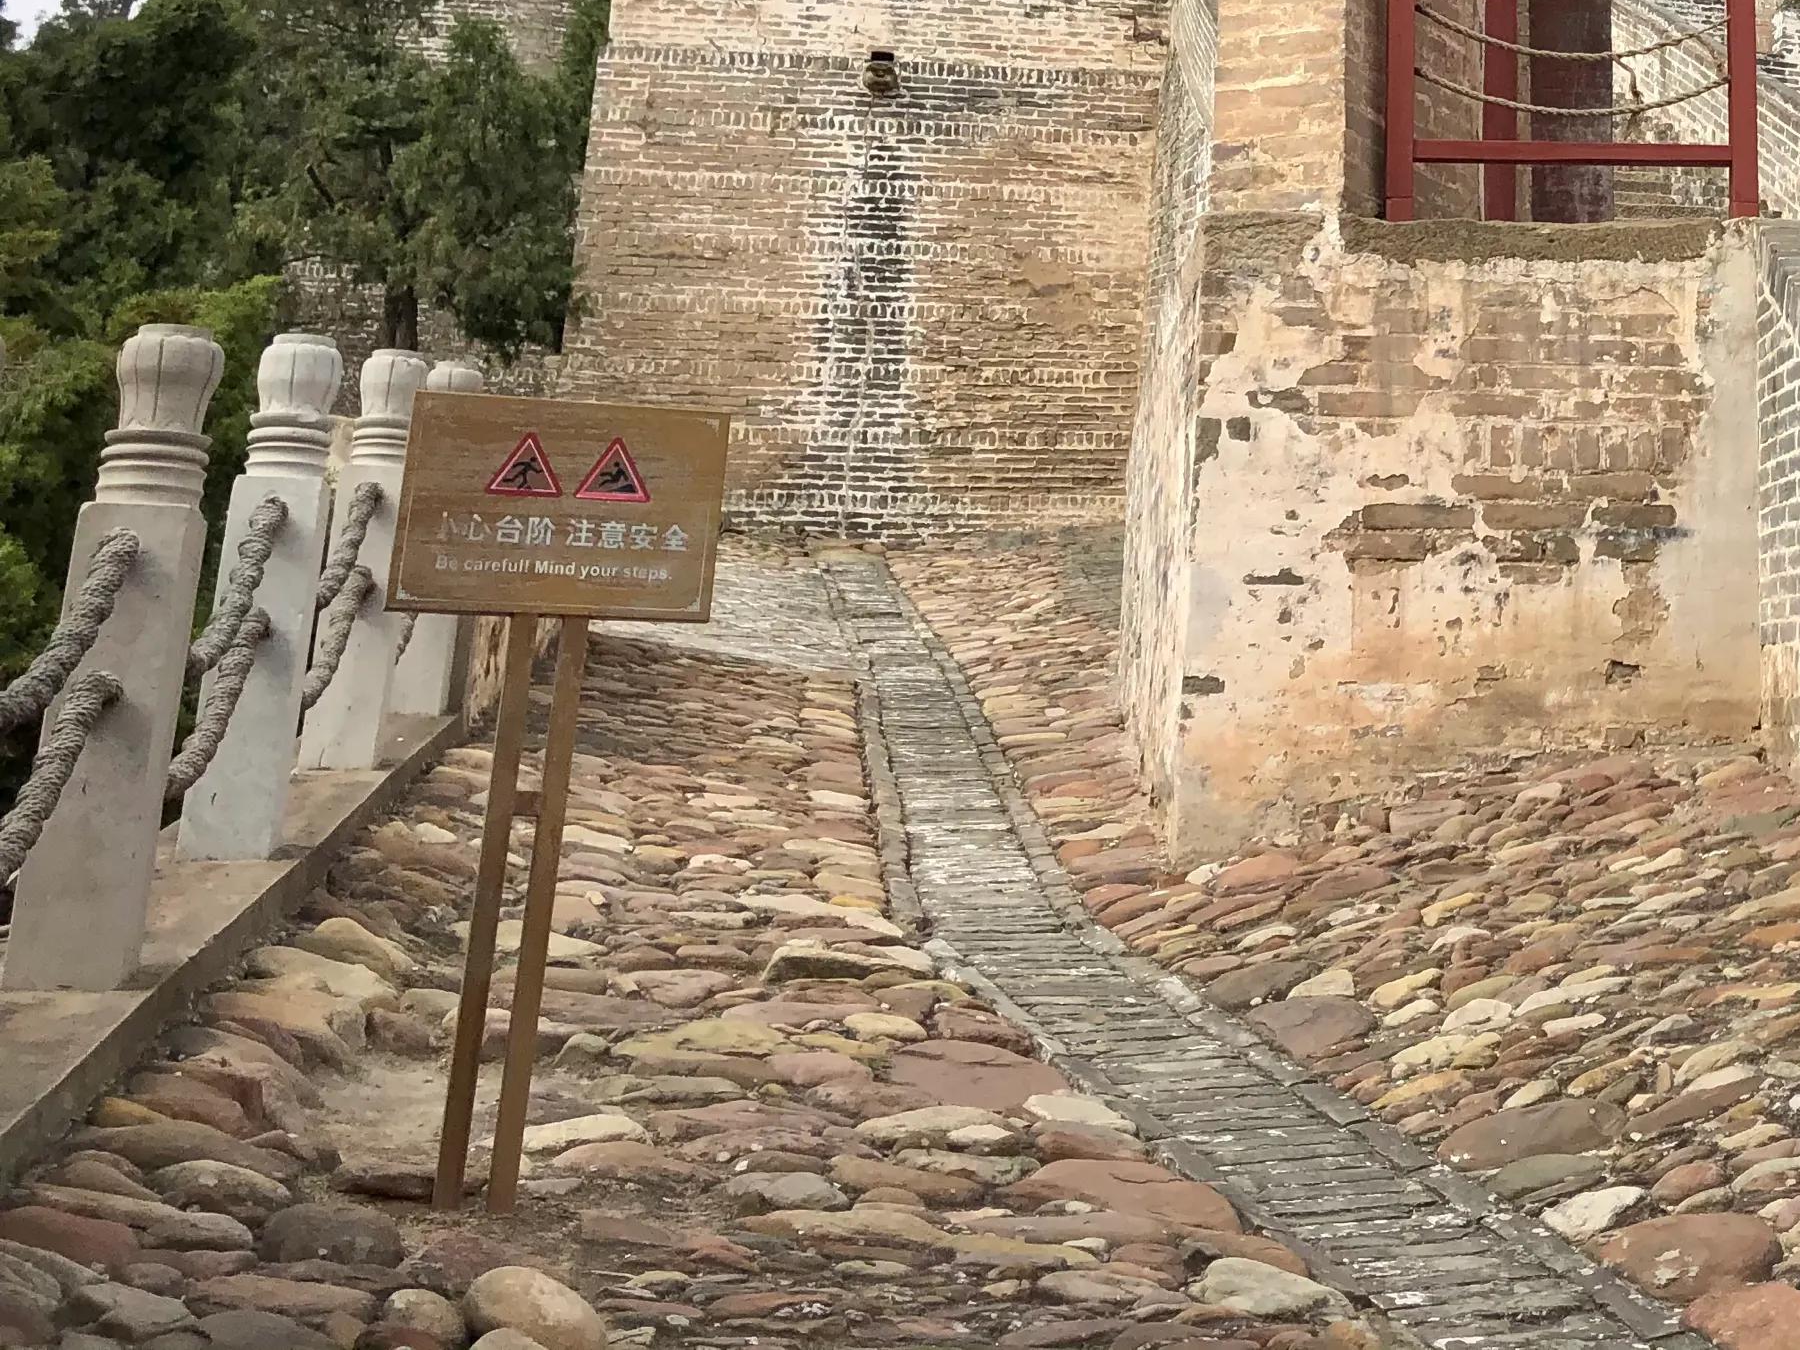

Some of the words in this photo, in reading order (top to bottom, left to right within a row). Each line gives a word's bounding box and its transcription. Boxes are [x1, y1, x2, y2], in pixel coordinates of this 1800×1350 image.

[436, 511, 555, 546] 小心台阶
[566, 518, 689, 551] 注意安全
[435, 554, 458, 571] Be
[463, 558, 530, 574] careful!
[534, 559, 576, 575] Mind
[579, 564, 620, 580] your
[623, 567, 673, 582] steps.
